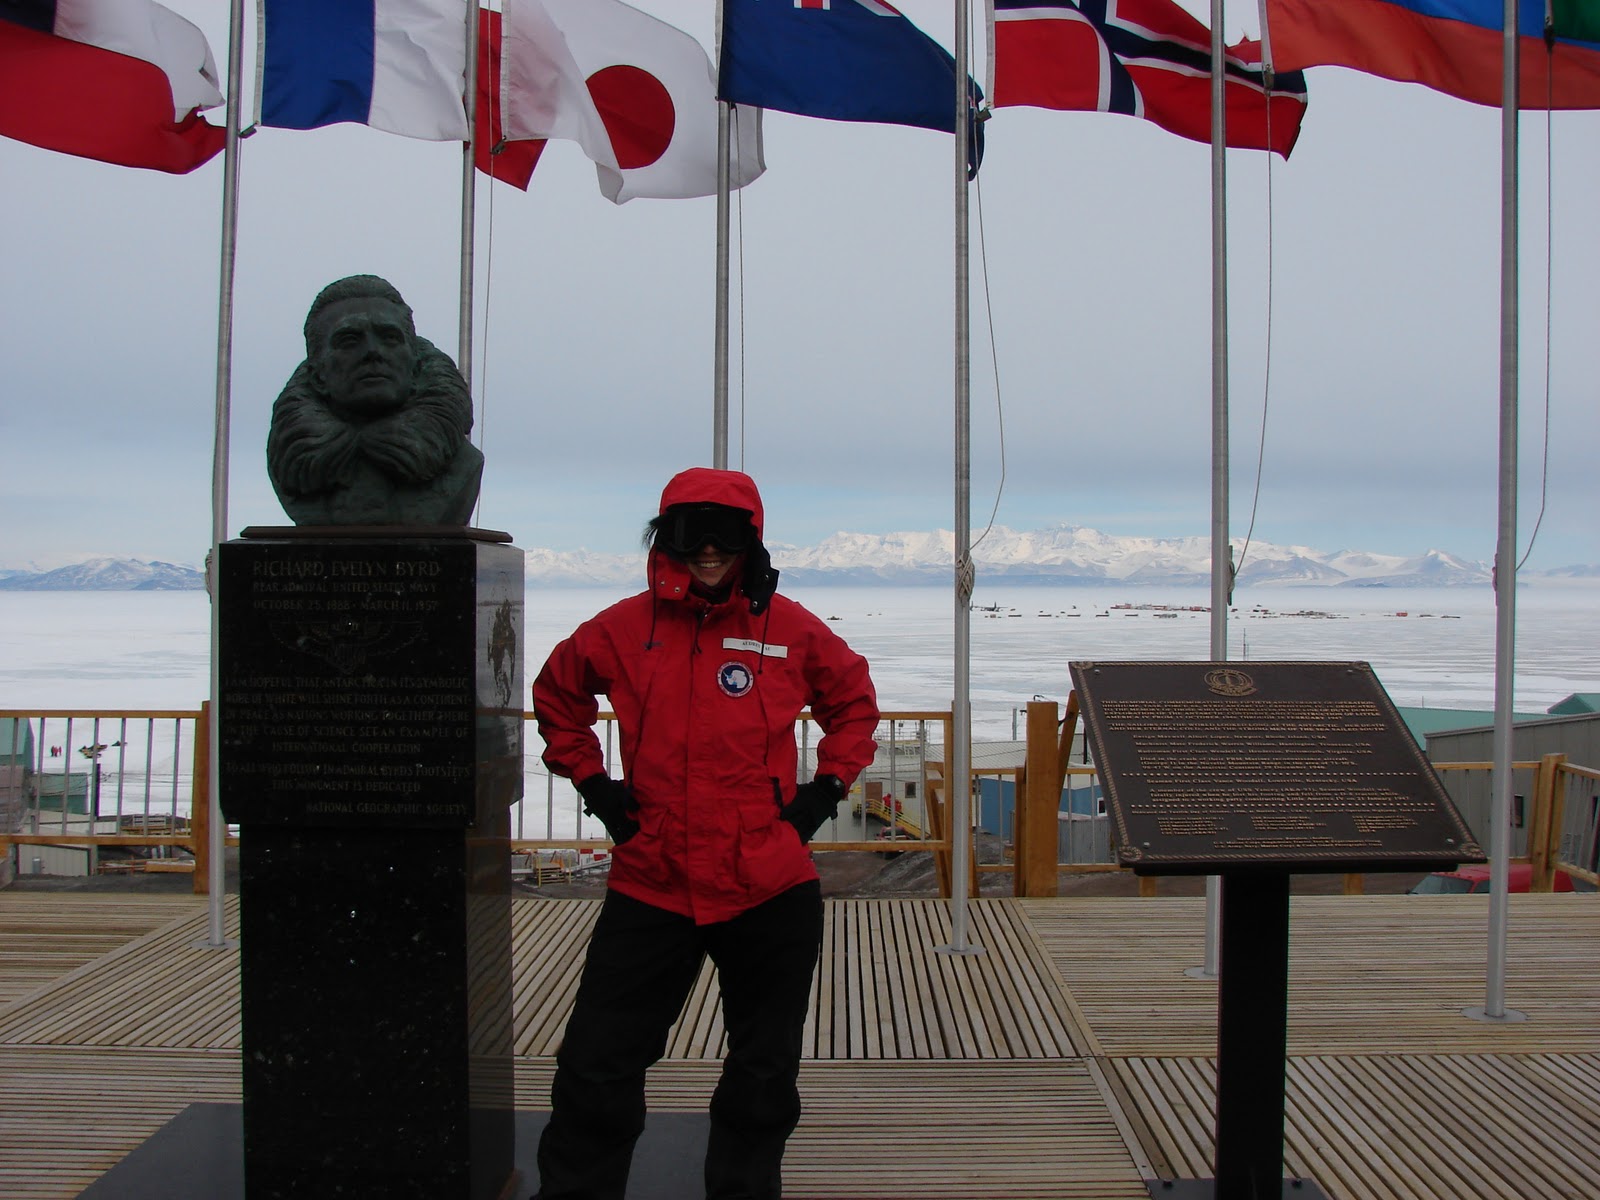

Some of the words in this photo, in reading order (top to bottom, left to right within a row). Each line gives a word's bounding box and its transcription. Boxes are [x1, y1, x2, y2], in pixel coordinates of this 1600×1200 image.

[253, 560, 325, 576] RICHARD
[331, 560, 387, 576] EVELYN
[396, 560, 442, 576] BYRD
[253, 582, 279, 592] REAR
[333, 582, 370, 592] UNITED
[372, 582, 405, 592] STATES
[410, 582, 437, 592] NAVY
[254, 600, 304, 610] OCTOBER
[249, 676, 294, 688] HOPEFUL
[296, 676, 321, 688] THAT
[265, 694, 297, 704] WHITE
[323, 694, 352, 704] SHINE
[331, 710, 378, 720] WORKING
[264, 726, 296, 736] CAUSE
[298, 726, 311, 736] OF
[314, 726, 356, 736] SCIENCE
[382, 726, 396, 736] AN
[400, 726, 450, 736] EXAMPLE
[456, 726, 470, 736] OF
[272, 742, 347, 752] INTERNATIONAL
[352, 742, 422, 752] COOPERATION
[366, 782, 421, 792] DEDICATED
[357, 802, 422, 814] GEOGRAPHIC
